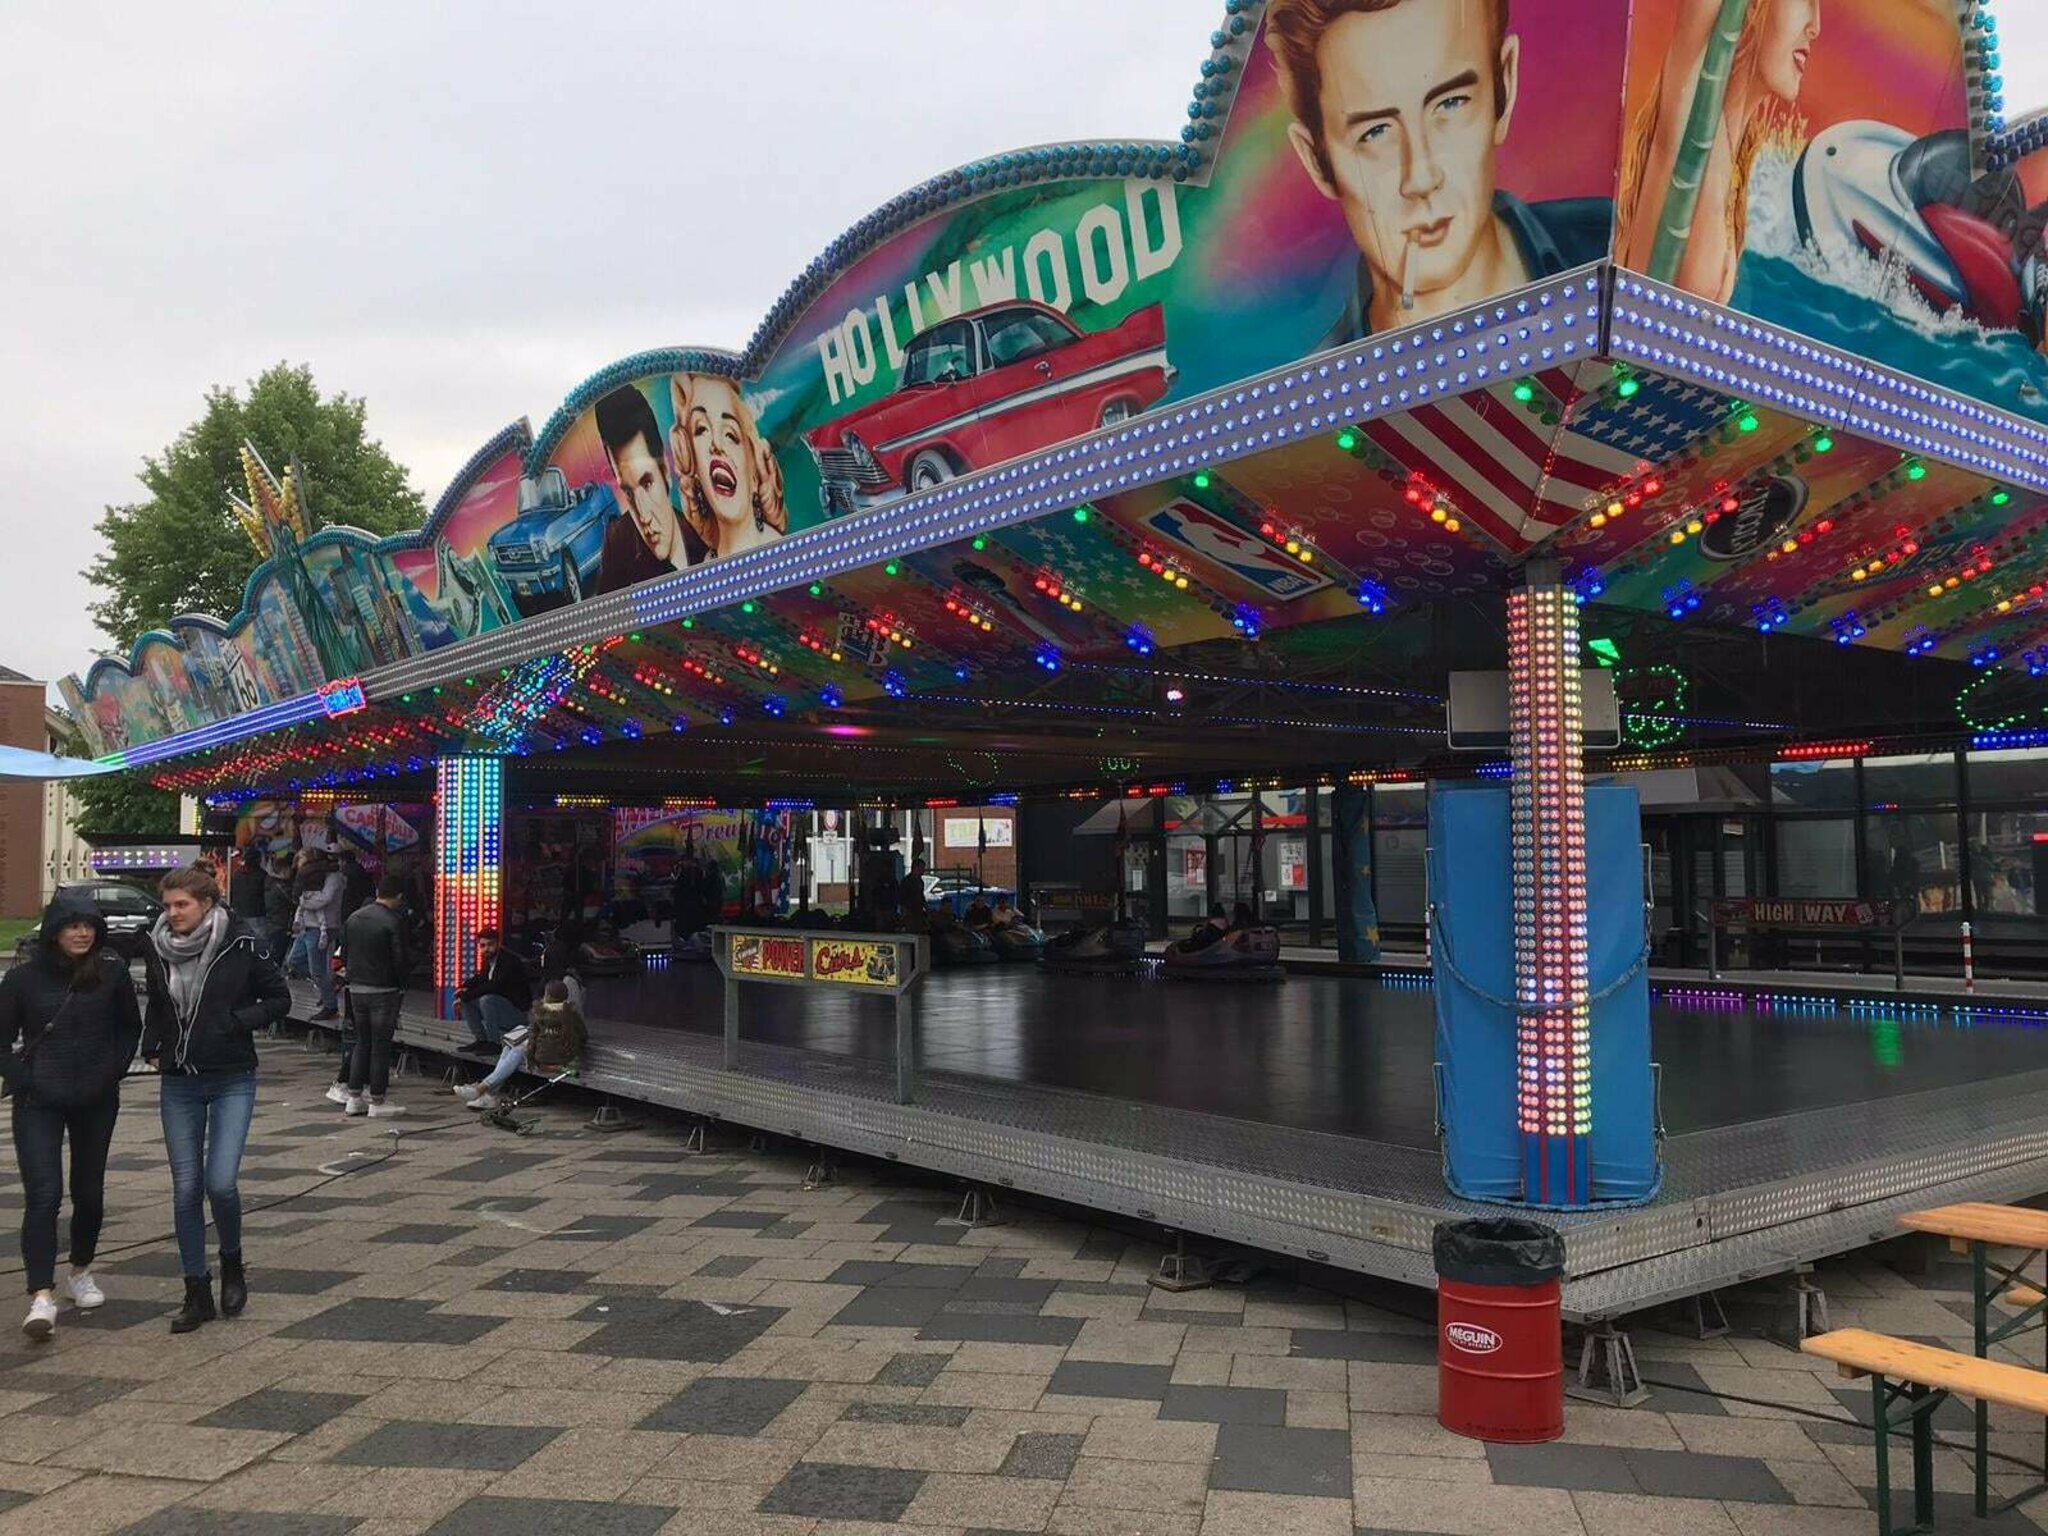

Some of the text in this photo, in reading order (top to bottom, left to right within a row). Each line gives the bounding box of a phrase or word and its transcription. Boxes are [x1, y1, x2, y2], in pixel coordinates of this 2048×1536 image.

[816, 178, 1183, 406] HOLLYWOOD
[1267, 573, 1306, 592] NBA
[234, 662, 258, 710] 66
[1754, 902, 1795, 922] HIGH
[1803, 903, 1848, 923] WAY
